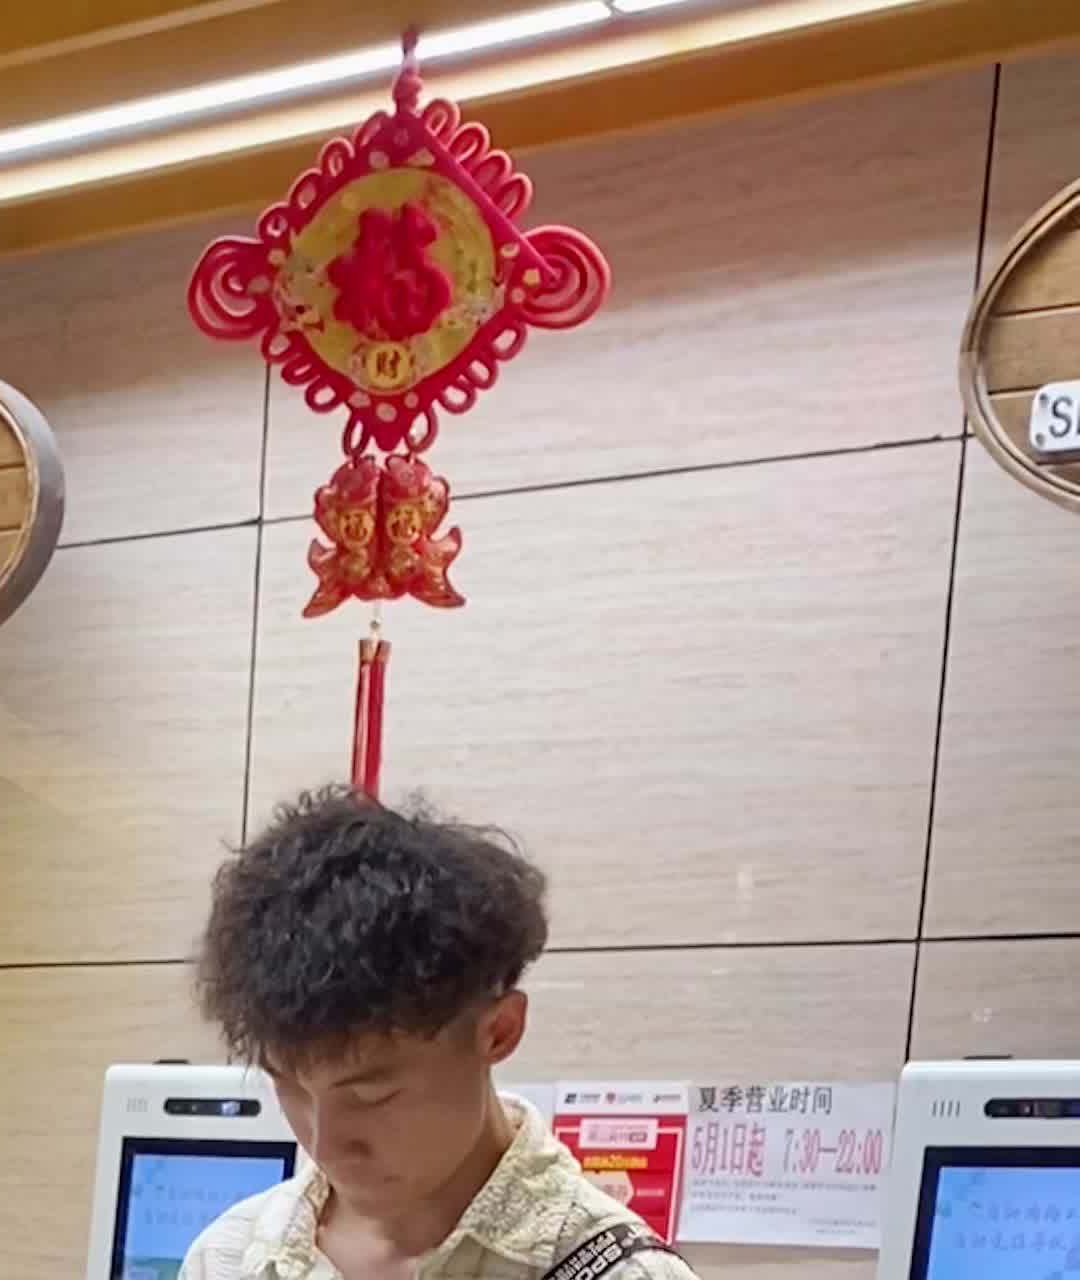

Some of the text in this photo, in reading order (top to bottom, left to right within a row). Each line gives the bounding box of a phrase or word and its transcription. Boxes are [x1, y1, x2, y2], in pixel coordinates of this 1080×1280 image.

[1049, 395, 1080, 439] S
[698, 1086, 834, 1116] 夏季营业时间
[691, 1121, 767, 1177] 5月1日起
